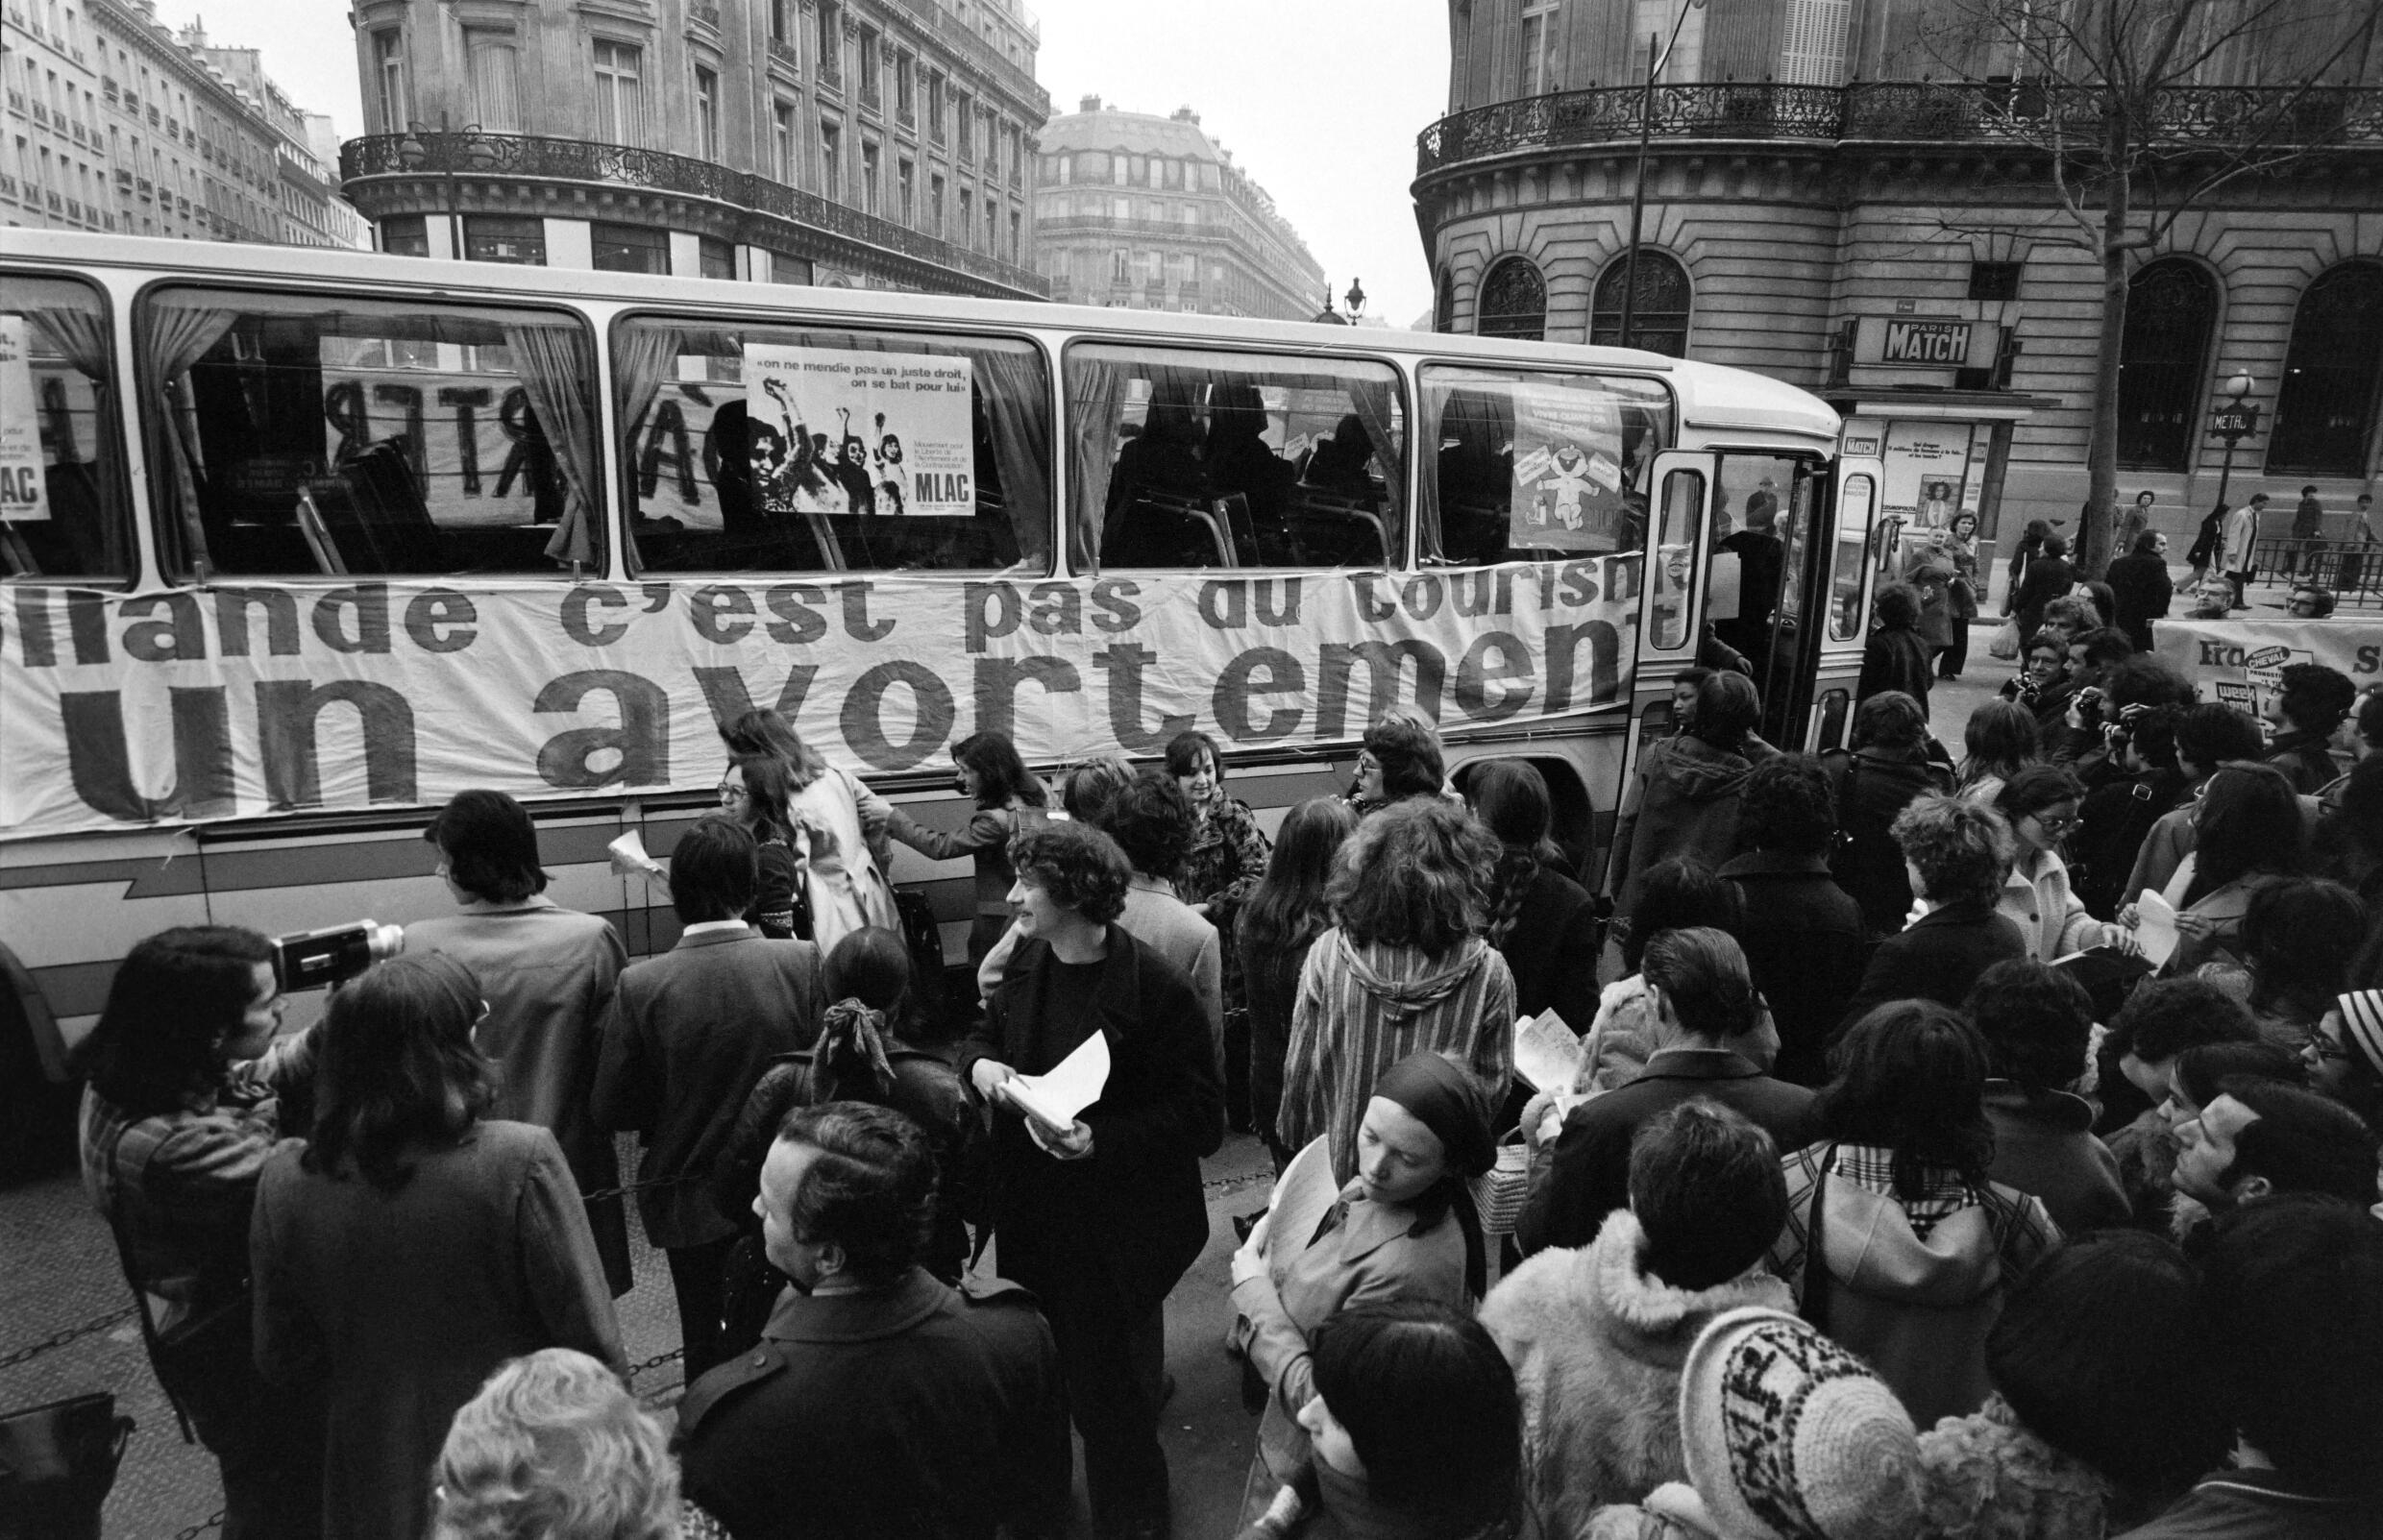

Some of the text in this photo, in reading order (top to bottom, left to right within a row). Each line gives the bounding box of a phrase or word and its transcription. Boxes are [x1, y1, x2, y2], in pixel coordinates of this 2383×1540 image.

[1910, 324, 1953, 333] PARIS
[1885, 324, 1969, 362] MATCH
[784, 360, 800, 371] ne
[803, 360, 851, 373] mendie
[854, 365, 877, 377] pas
[881, 367, 897, 376] un
[901, 365, 932, 378] juste
[850, 379, 868, 388] on
[872, 379, 887, 389] se
[890, 379, 911, 390] bat
[915, 381, 943, 393] pour
[1846, 439, 1876, 454] MATCH
[0, 467, 38, 503] AC
[916, 473, 970, 502] MLAC
[0, 582, 479, 668] llande
[963, 578, 1142, 653] pas
[1197, 576, 1302, 629] du
[1347, 550, 1688, 623] tourism
[2199, 639, 2247, 668] Fra
[2248, 651, 2286, 669] CHEVAL
[2248, 670, 2283, 679] PRONOSTI
[2218, 685, 2256, 701] week
[60, 678, 418, 822] un
